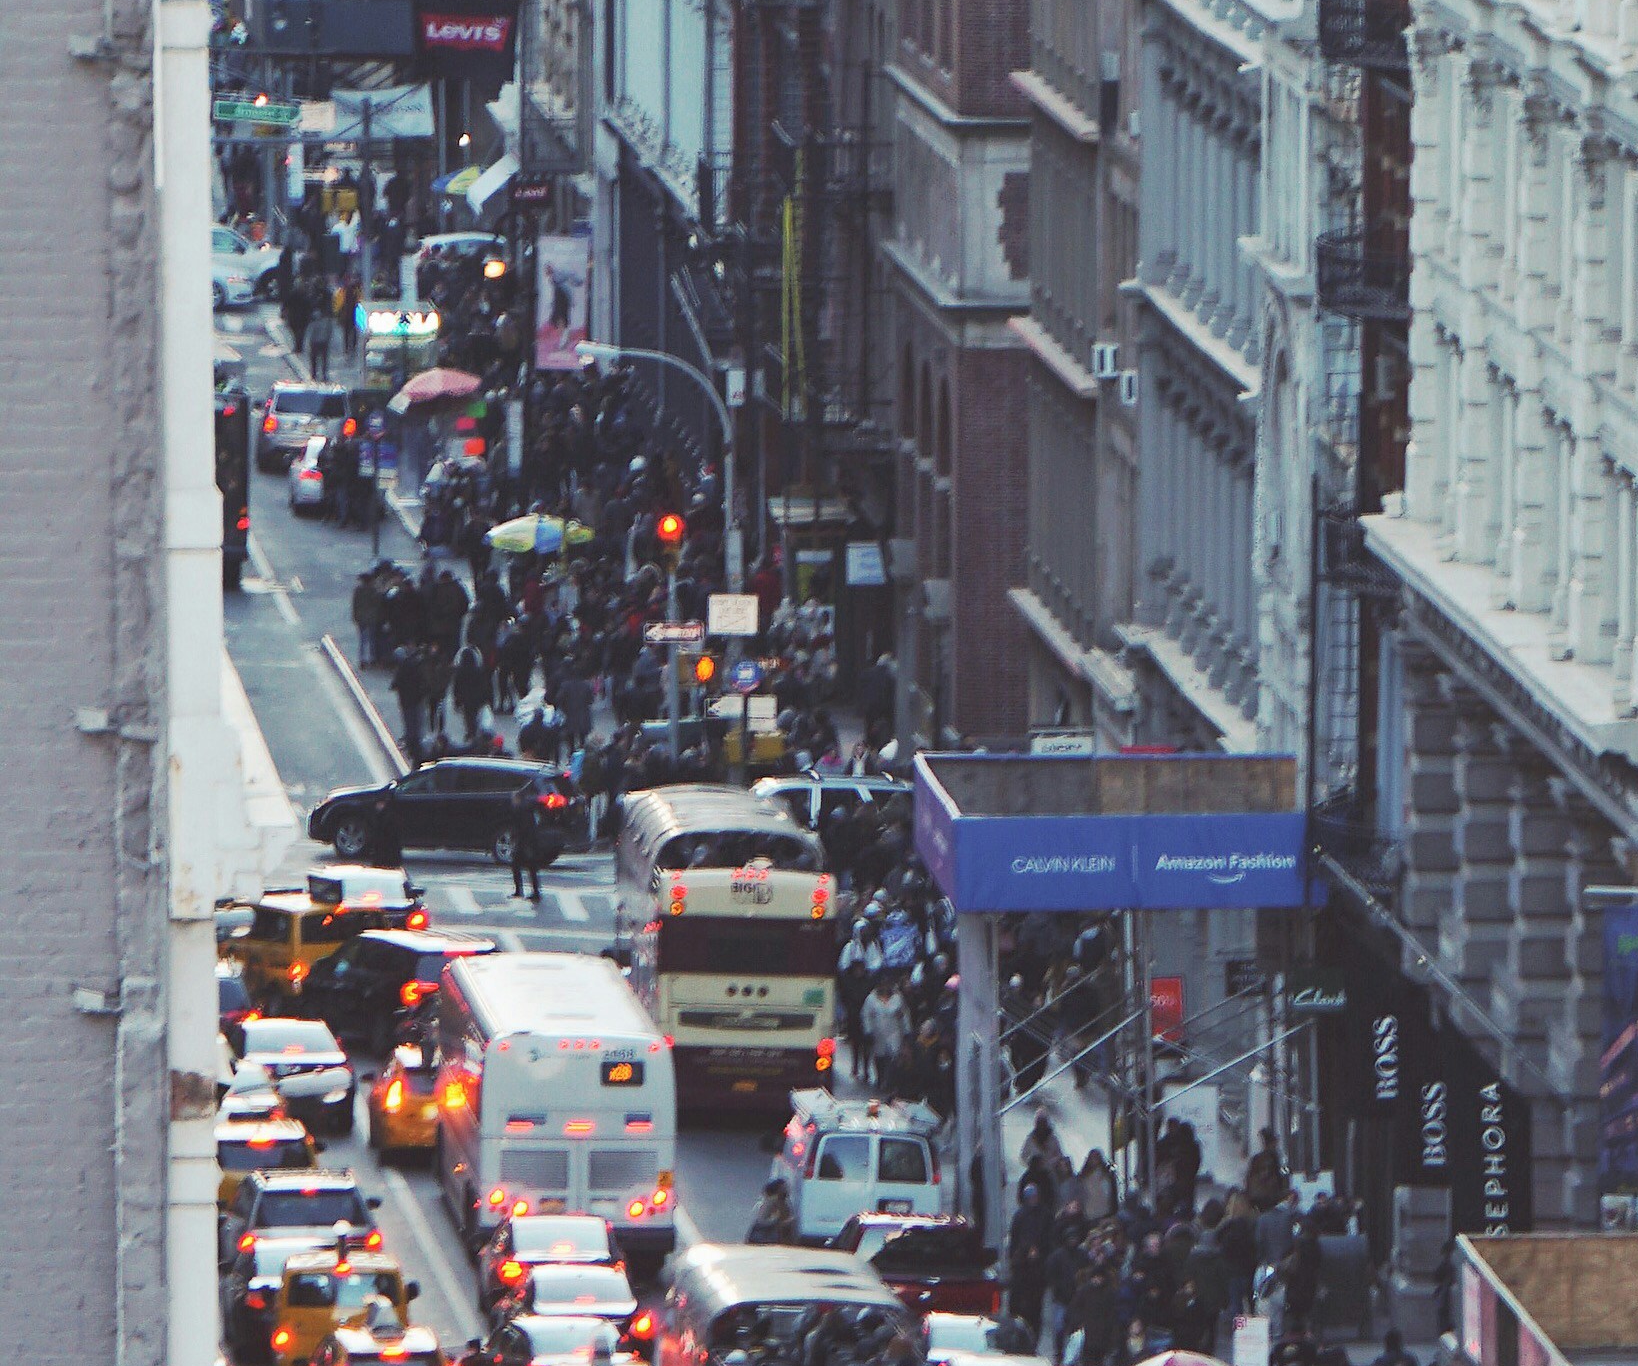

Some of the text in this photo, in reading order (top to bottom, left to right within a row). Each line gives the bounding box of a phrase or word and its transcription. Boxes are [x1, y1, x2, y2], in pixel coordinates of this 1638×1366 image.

[1011, 854, 1116, 874] CALVIN KLEIN
[1155, 852, 1297, 871] Amazon Fashion
[1373, 1014, 1399, 1099] BOSS
[1420, 1081, 1448, 1166] BOSS
[1480, 1081, 1510, 1236] SEPHORA
